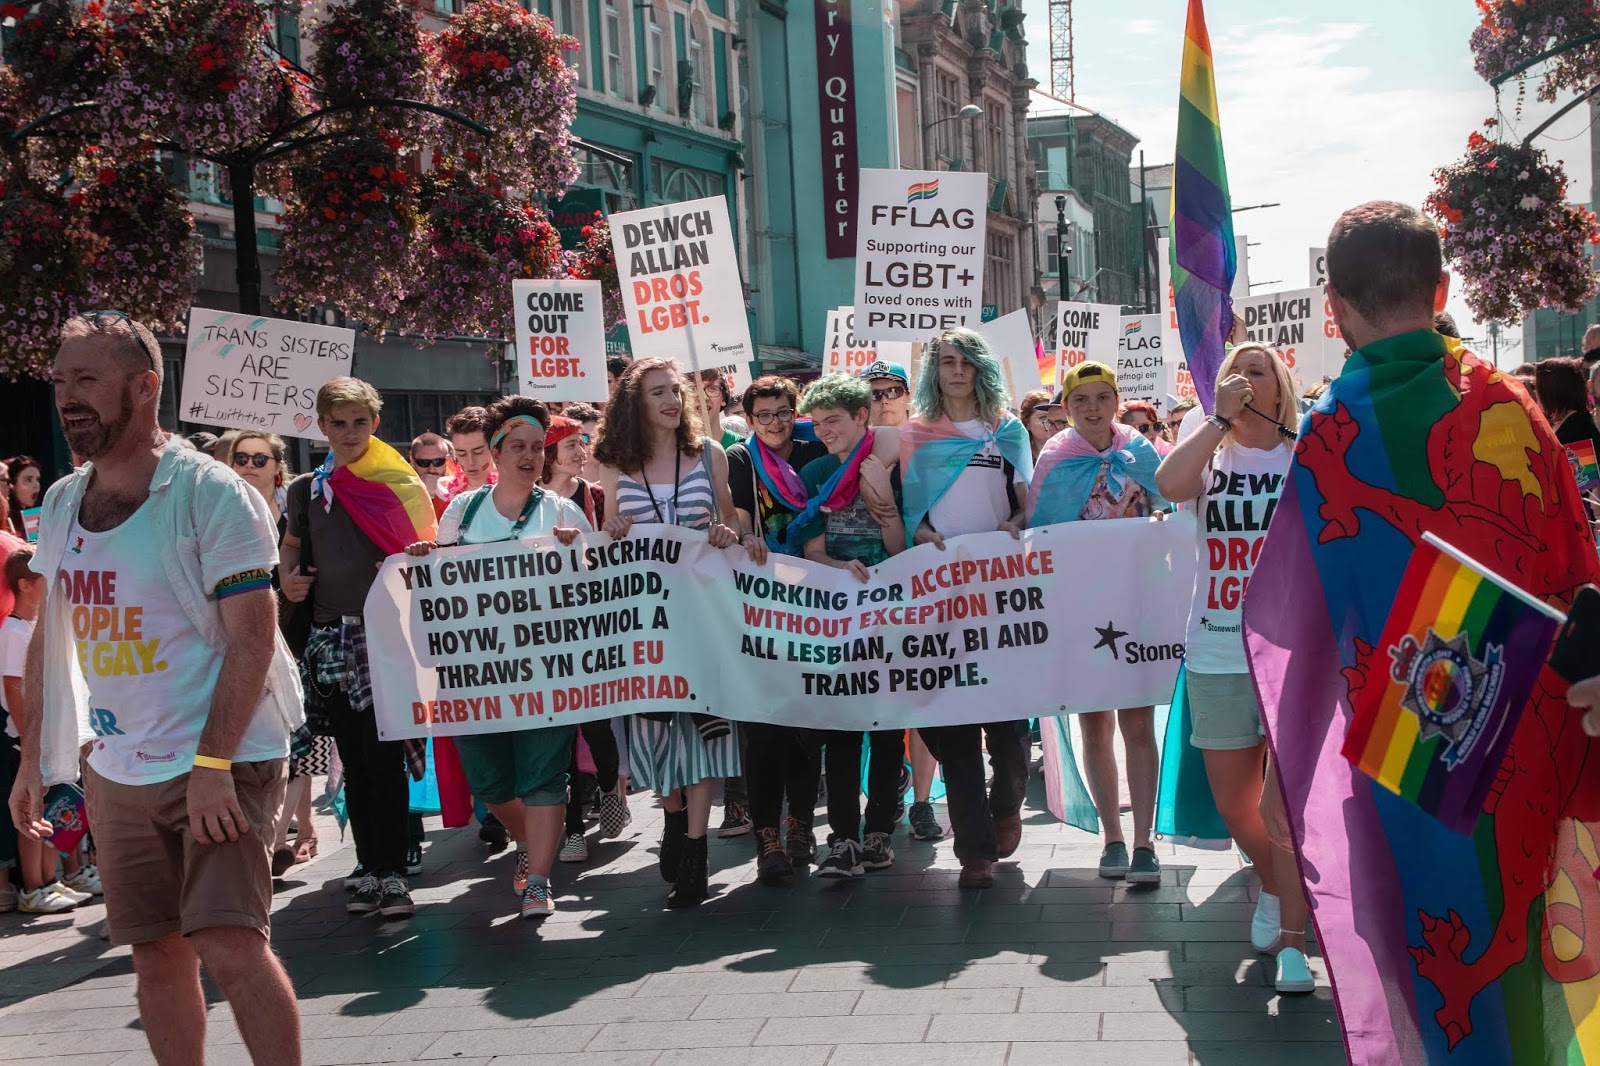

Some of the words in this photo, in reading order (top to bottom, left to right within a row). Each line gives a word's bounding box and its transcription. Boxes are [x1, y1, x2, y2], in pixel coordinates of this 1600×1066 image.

[825, 76, 849, 237] Quarter
[623, 210, 713, 248] DEWCH
[871, 205, 974, 229] FFLAG
[630, 240, 709, 277] ALLAN
[866, 239, 947, 257] Supporting
[951, 245, 976, 255] our
[633, 271, 703, 306] DROS
[865, 261, 974, 290] LGBT+
[527, 292, 584, 312] COME
[864, 292, 902, 306] loved
[906, 296, 939, 307] ones
[944, 295, 972, 309] with
[1244, 297, 1311, 327] DEWCH
[528, 314, 569, 333] OUT
[638, 300, 710, 334] LGBT.
[868, 312, 966, 330] PRIDE!
[1063, 310, 1100, 330] COME
[204, 326, 268, 348] TRANS
[280, 335, 349, 361] SISTERS
[529, 336, 570, 356] FOR
[718, 343, 744, 352] Stonewall
[1062, 329, 1088, 349] OUT
[240, 353, 292, 380] ARE
[531, 358, 586, 378] LGBT.
[845, 350, 878, 367] FOR
[1117, 356, 1163, 369] FALCH
[1145, 371, 1157, 379] ein
[205, 374, 316, 410] SISTERS
[188, 401, 282, 427] #LwiththeT
[1206, 469, 1285, 497] DEW
[398, 564, 432, 591] YN
[440, 549, 562, 586] GWEITHIO
[571, 549, 579, 573] I
[586, 537, 682, 571] SICRHAU
[733, 569, 849, 611] WORKING
[856, 583, 904, 607] FOR
[911, 549, 1054, 600] ACCEPTANCE
[1207, 576, 1249, 610] LG
[420, 595, 469, 622] BOD
[476, 588, 542, 617] POBL
[549, 571, 670, 609] LESBIAIDD,
[742, 601, 852, 639] WITHOUT
[859, 593, 987, 630] EXCEPTION
[995, 586, 1045, 615] FOR
[428, 626, 506, 655] HOYW,
[513, 606, 643, 649] DEURYWIOL
[651, 605, 669, 630] A
[741, 634, 779, 661] ALL
[787, 635, 894, 665] LESBIAN,
[902, 632, 957, 660] GAY,
[963, 626, 989, 653] BI
[997, 620, 1049, 649] AND
[1207, 623, 1241, 633] Stonewall
[92, 638, 169, 677] GAY.
[436, 657, 533, 690] THRAWS
[540, 653, 575, 680] YN
[581, 644, 627, 674] CAEL
[633, 640, 664, 665] EU
[801, 669, 880, 697] TRANS
[888, 662, 989, 693] PEOPLE.
[412, 695, 502, 726] DERBYN
[509, 691, 545, 717] YN
[553, 674, 697, 715] DDIEITHRIAD.
